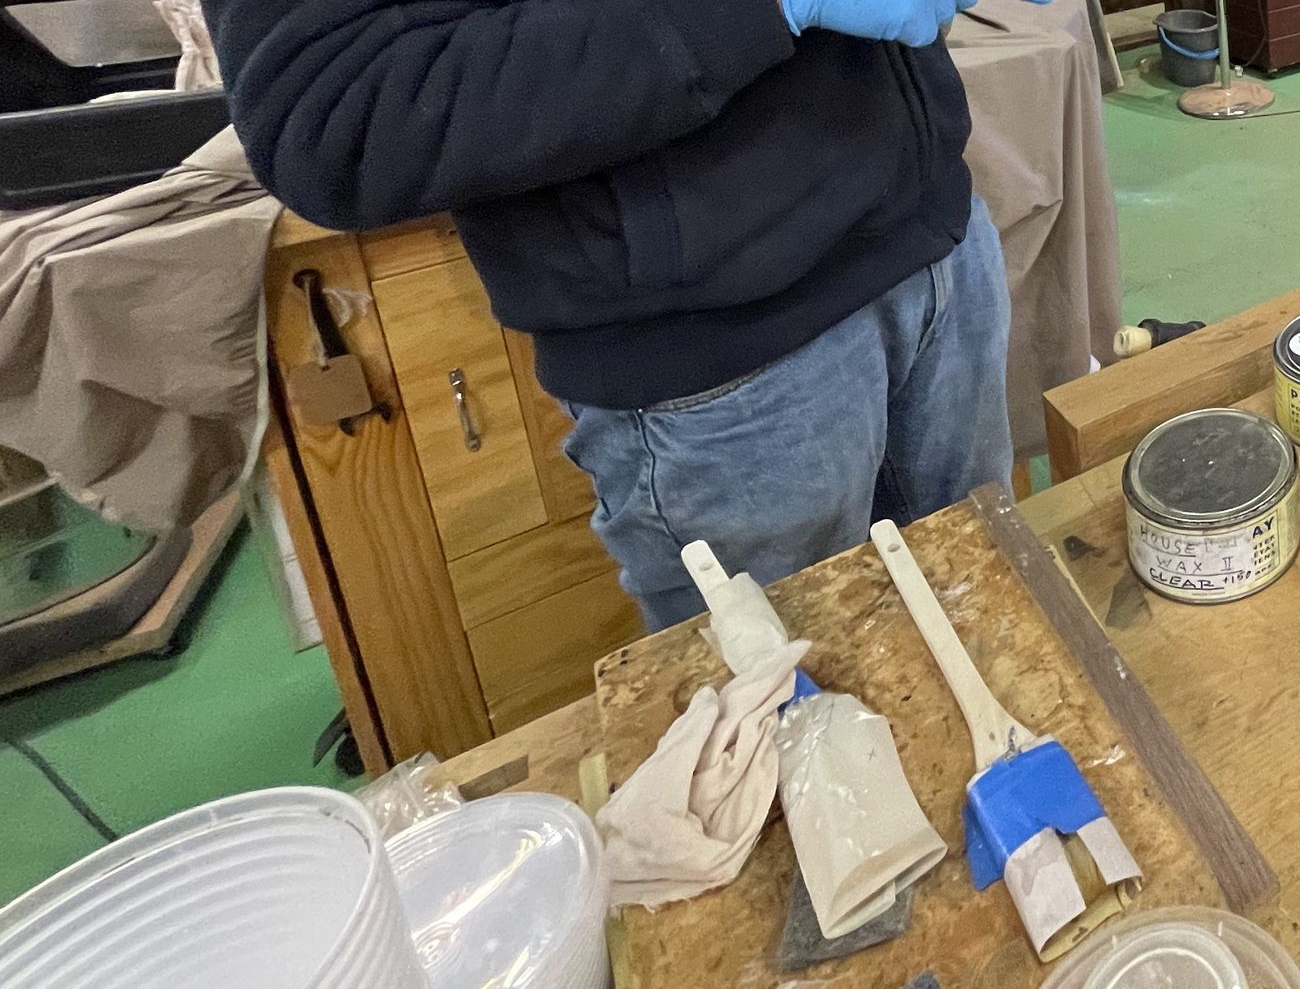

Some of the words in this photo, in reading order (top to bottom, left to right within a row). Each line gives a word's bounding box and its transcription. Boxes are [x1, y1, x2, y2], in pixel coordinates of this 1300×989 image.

[1140, 524, 1197, 555] HOUSE
[1156, 555, 1203, 574] WAX
[1149, 567, 1215, 589] CLEAR
